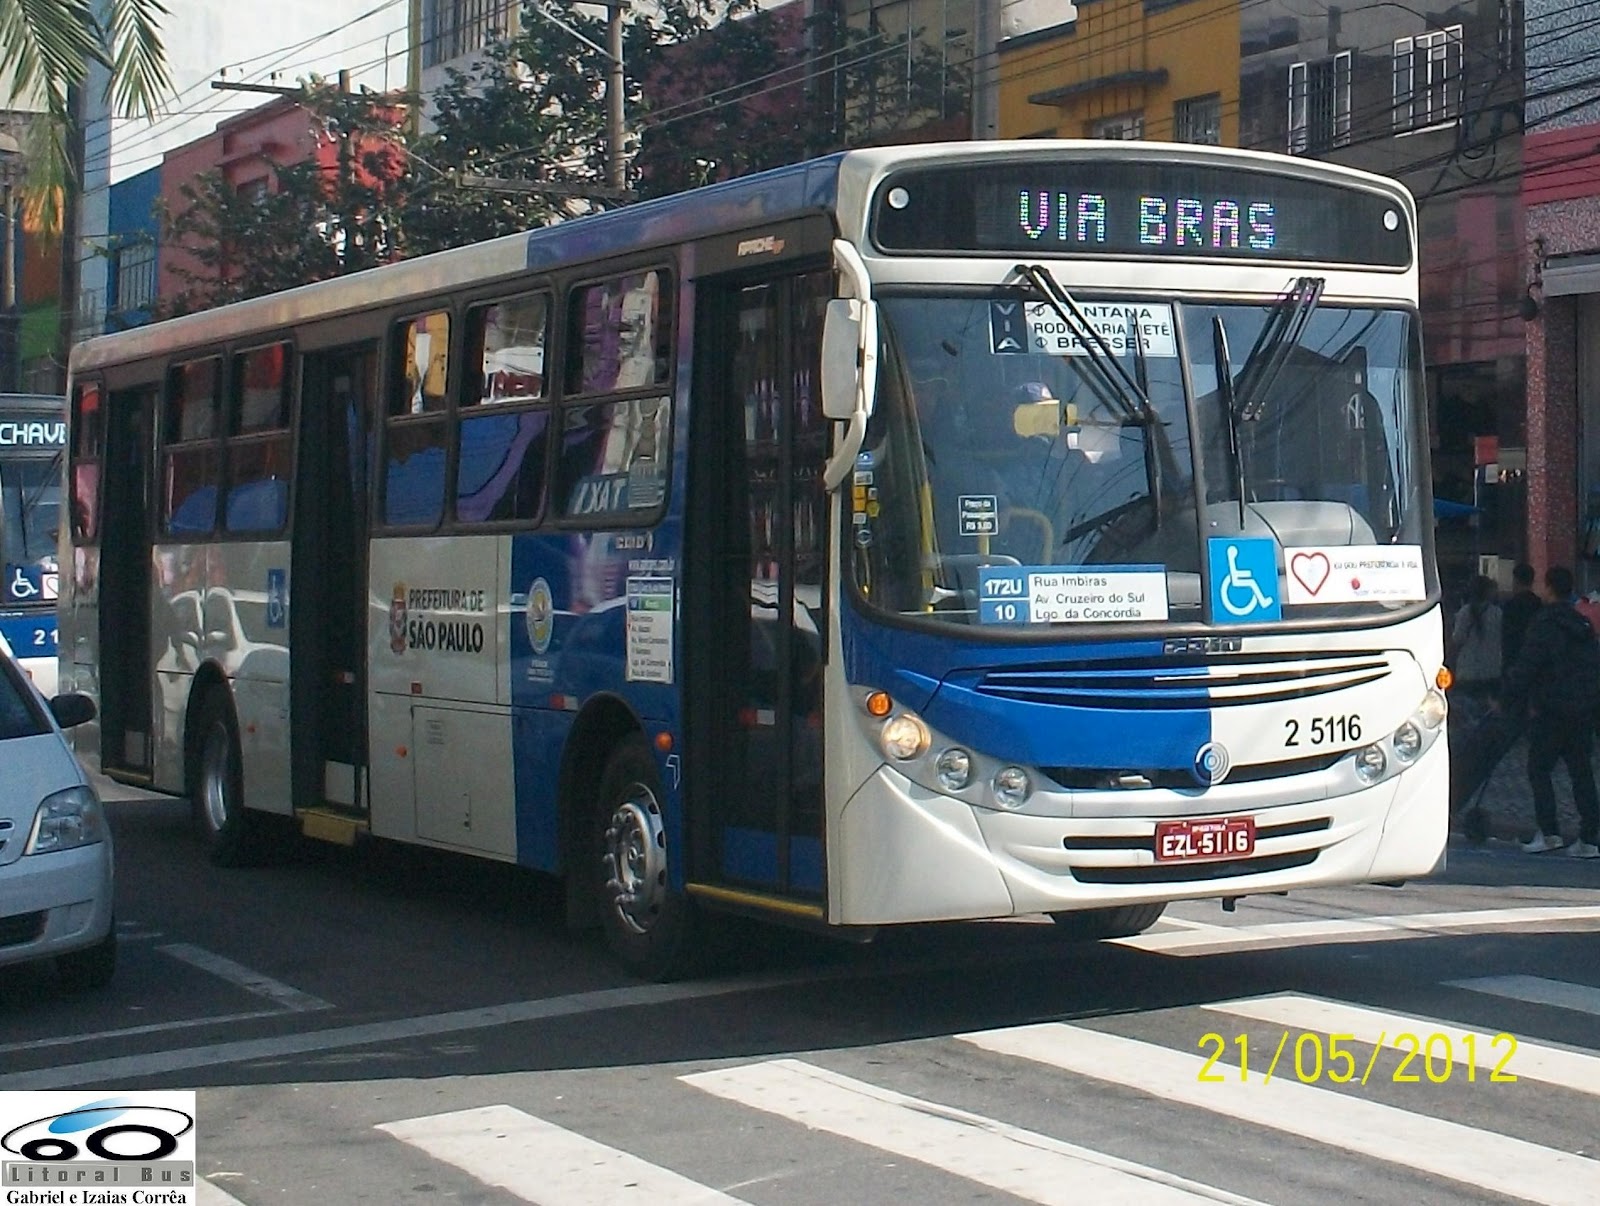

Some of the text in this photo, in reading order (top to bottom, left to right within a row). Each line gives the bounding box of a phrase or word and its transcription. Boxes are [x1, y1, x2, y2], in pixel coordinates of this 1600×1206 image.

[1020, 190, 1274, 249] VIA BRAS
[1055, 306, 1152, 319] NTANA
[1034, 322, 1126, 335] RODARIA
[984, 578, 1022, 595] 172U
[1034, 576, 1107, 587] Rua Imbiras
[409, 589, 484, 612] PREFEITURA DE
[1056, 593, 1104, 604] Cruzeiro
[1109, 593, 1123, 603] do
[1127, 592, 1145, 603] Sul
[994, 605, 1016, 620] 10
[1065, 609, 1079, 619] da
[33, 629, 46, 645] 2
[409, 615, 484, 653] SÃO PAULO
[1285, 714, 1362, 747] 2 5116
